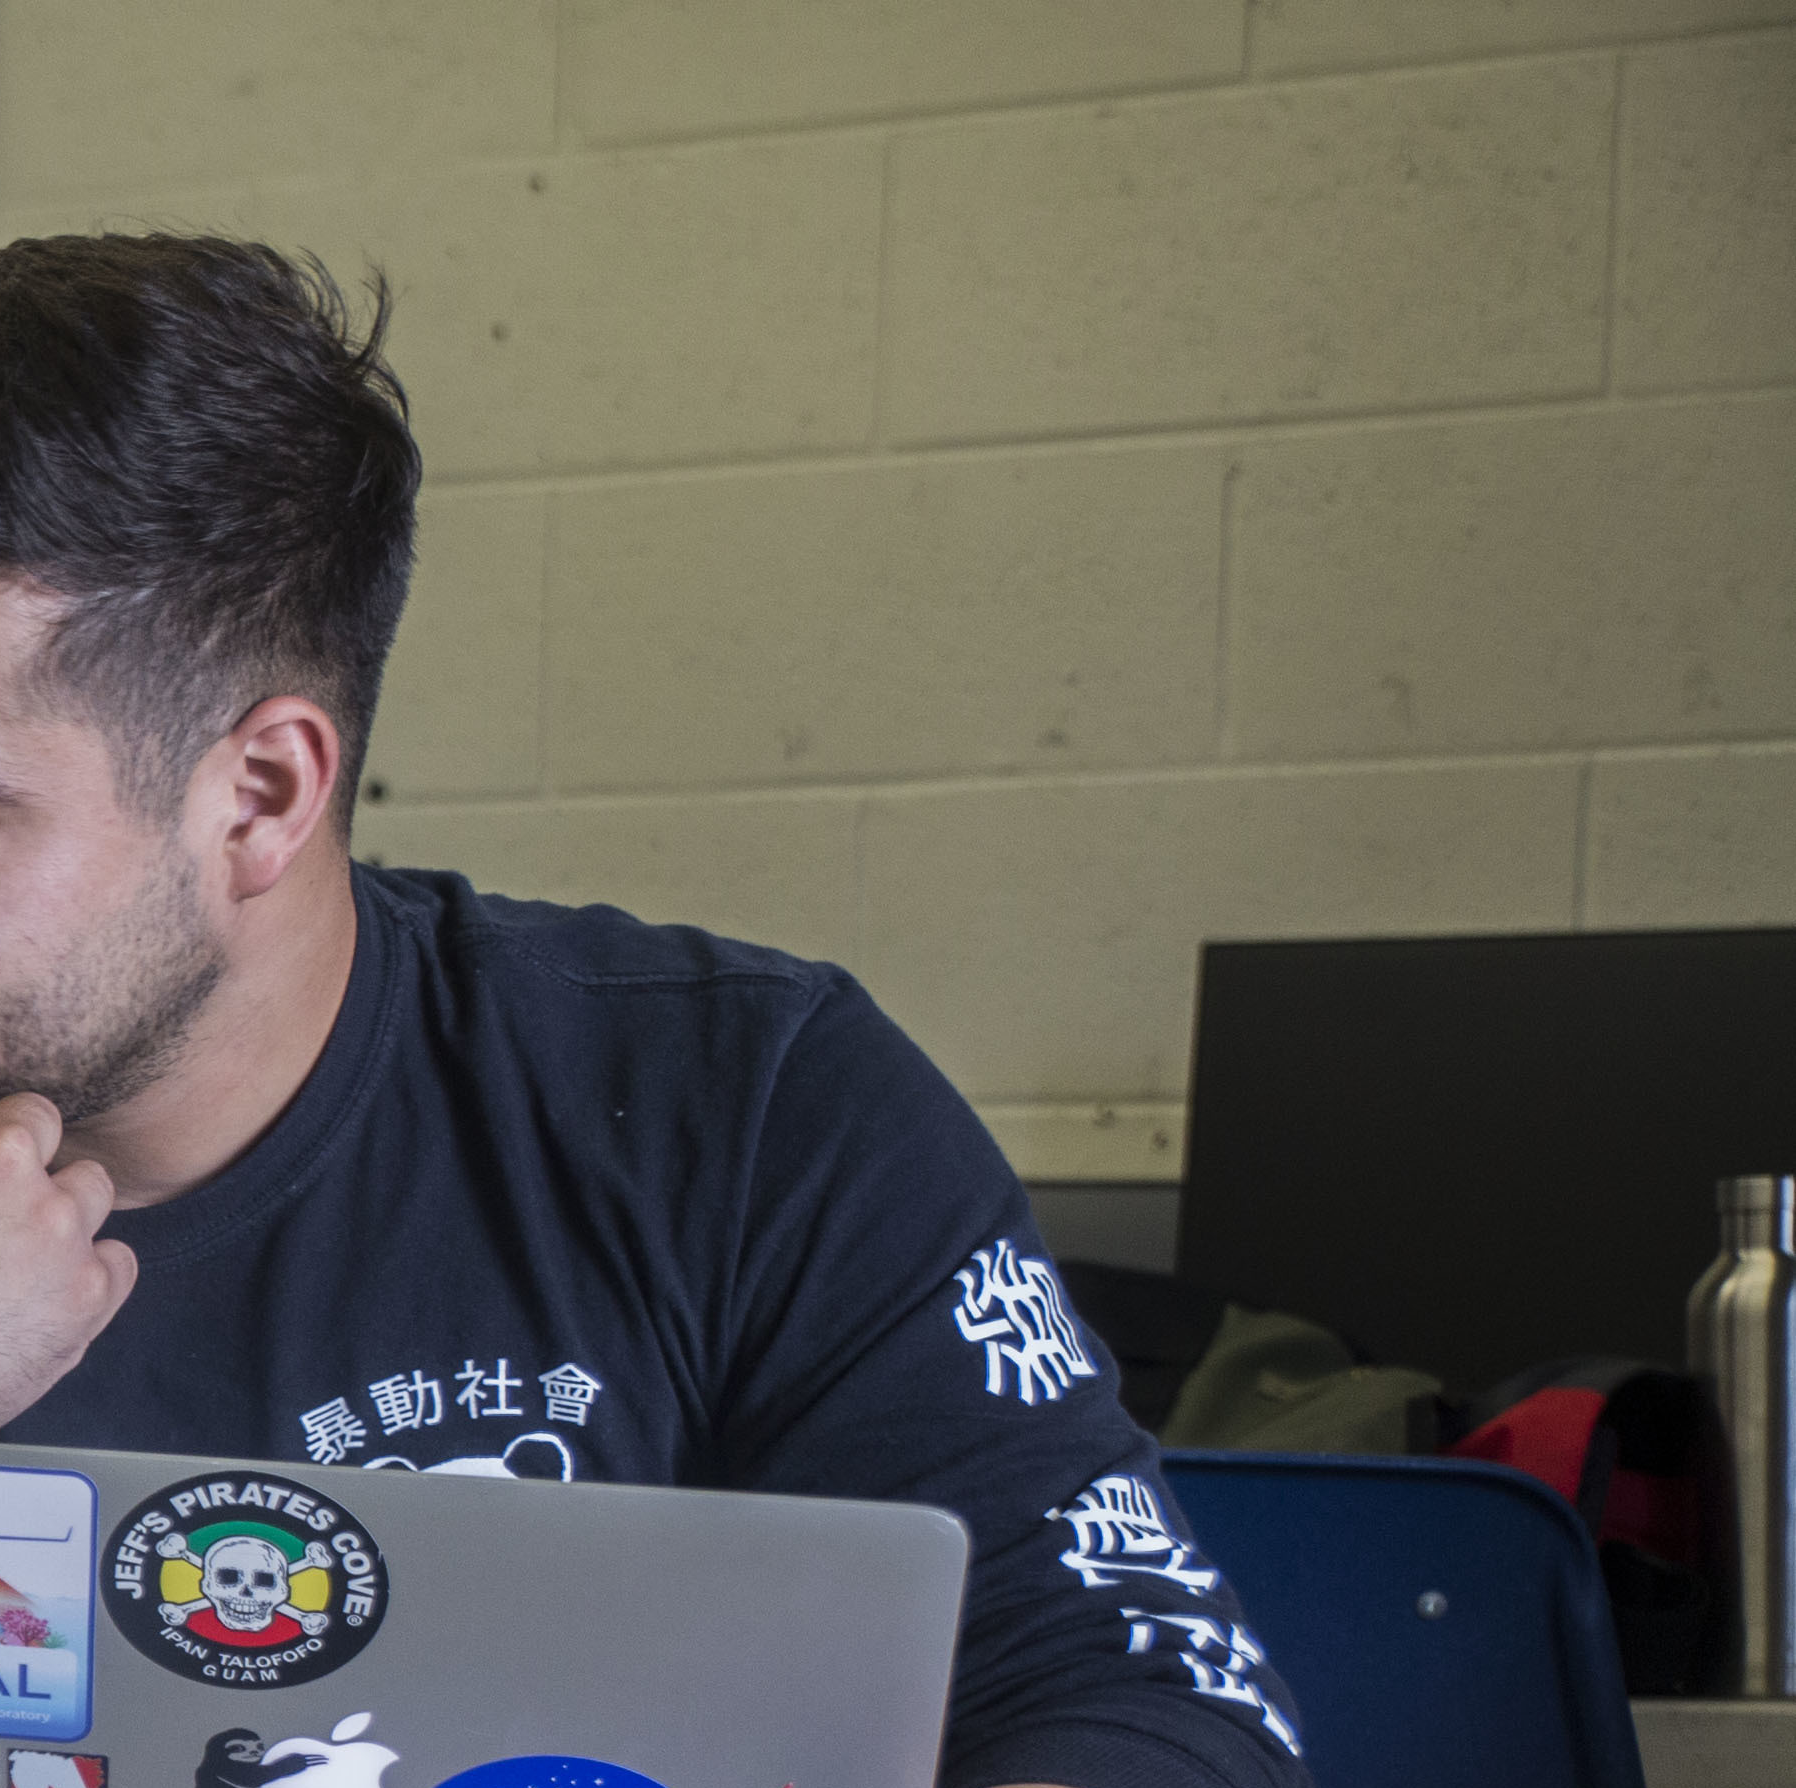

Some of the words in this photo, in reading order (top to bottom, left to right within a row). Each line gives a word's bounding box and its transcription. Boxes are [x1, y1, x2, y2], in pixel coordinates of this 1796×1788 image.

[299, 1357, 603, 1465] 暴動社會
[114, 1510, 172, 1600] JEFF'S
[169, 1481, 337, 1532] PIRATES
[159, 1626, 208, 1660] IPAN
[218, 1637, 324, 1669] TALOFOFO
[202, 1664, 279, 1682] GUAM
